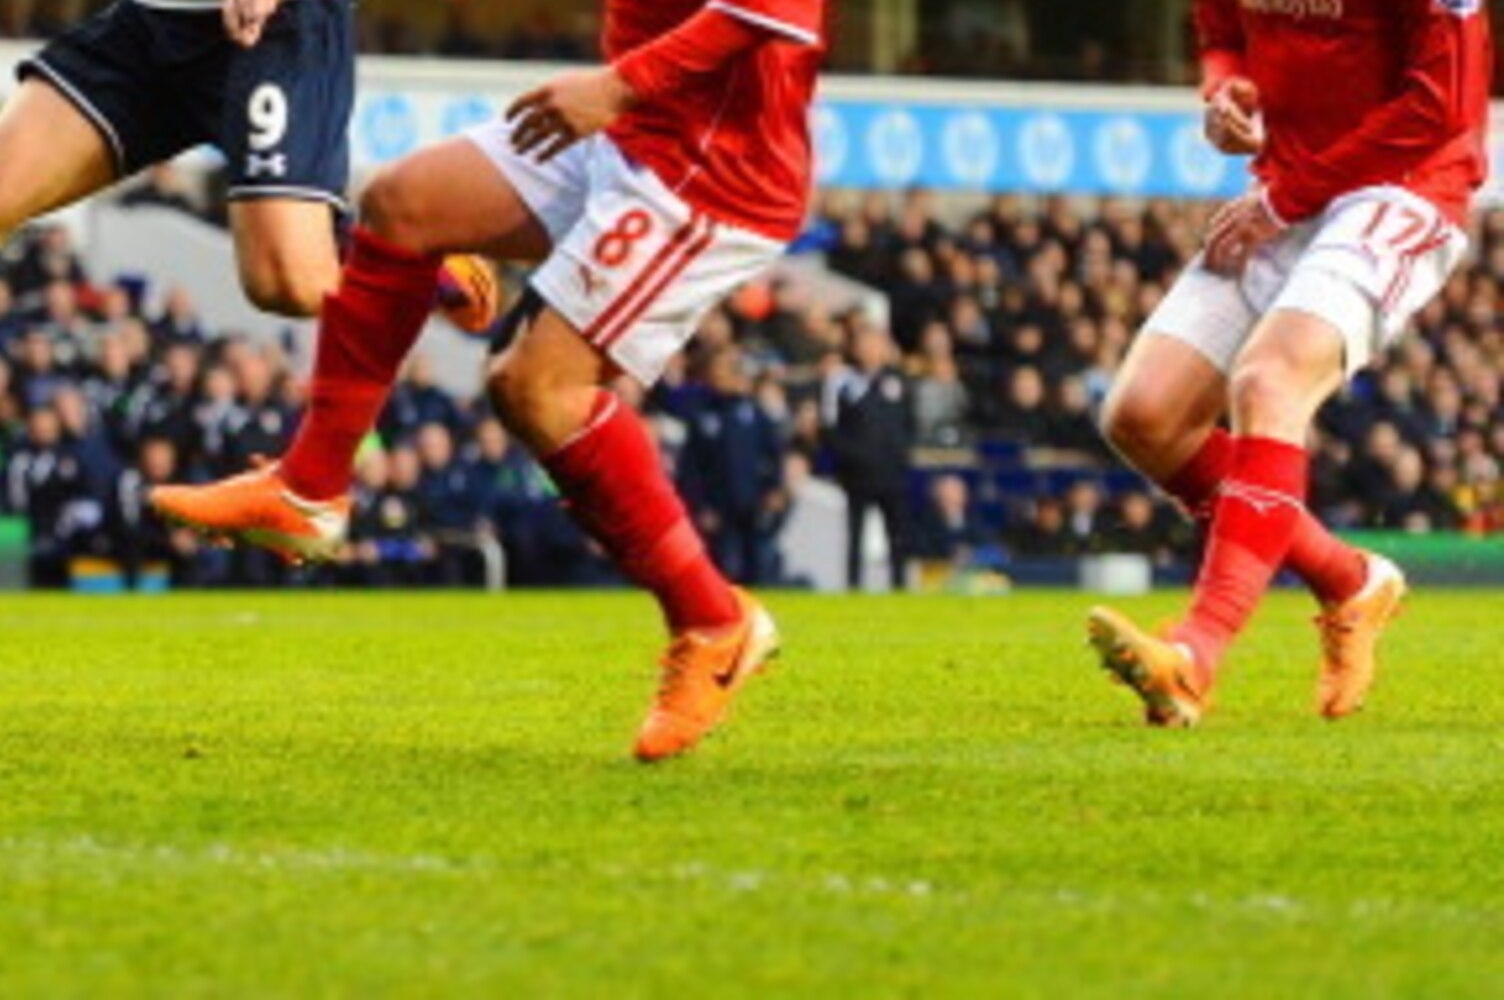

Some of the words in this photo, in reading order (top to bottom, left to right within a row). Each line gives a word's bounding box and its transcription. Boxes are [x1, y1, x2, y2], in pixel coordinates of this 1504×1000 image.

[247, 83, 287, 151] 9
[594, 207, 653, 268] 8
[1360, 200, 1426, 249] 17
